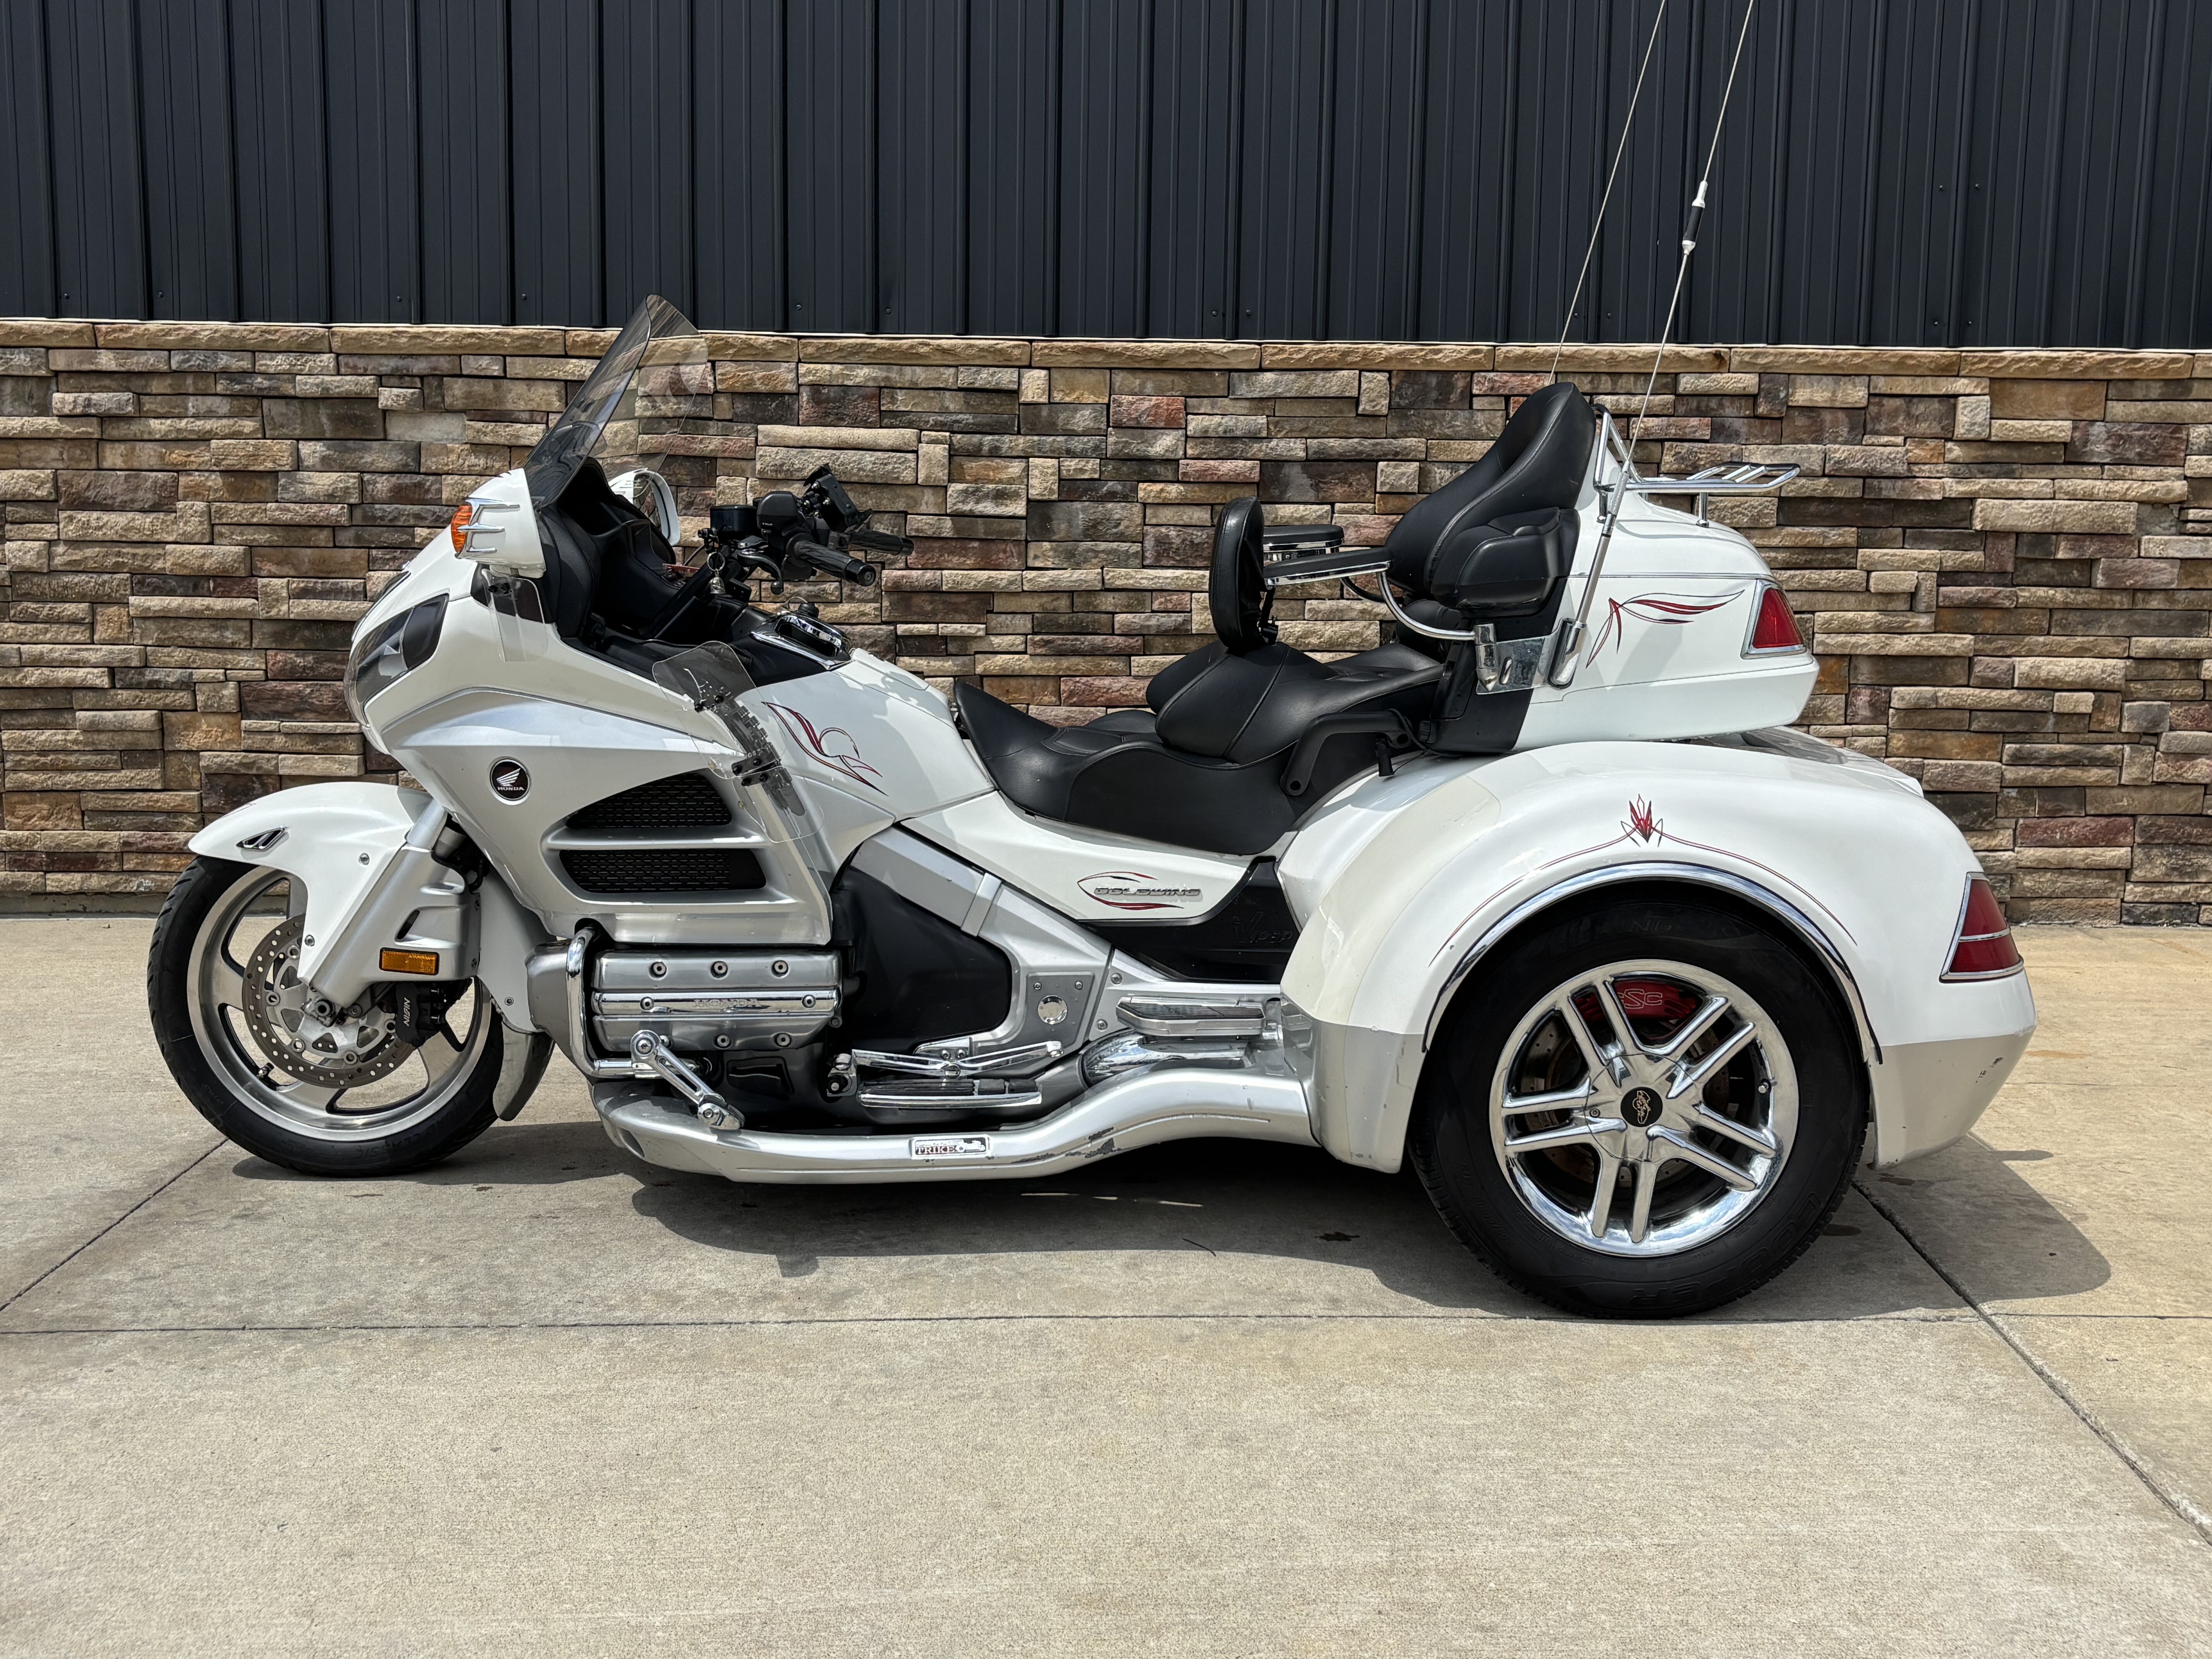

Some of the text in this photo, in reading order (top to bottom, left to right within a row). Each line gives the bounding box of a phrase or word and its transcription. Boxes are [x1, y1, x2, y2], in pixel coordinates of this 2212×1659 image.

[403, 997, 411, 1027] NISSIN
[693, 998, 762, 1008] HONDA
[916, 1145, 955, 1155] TRIKE
[1629, 1191, 1821, 1304] COOPER
